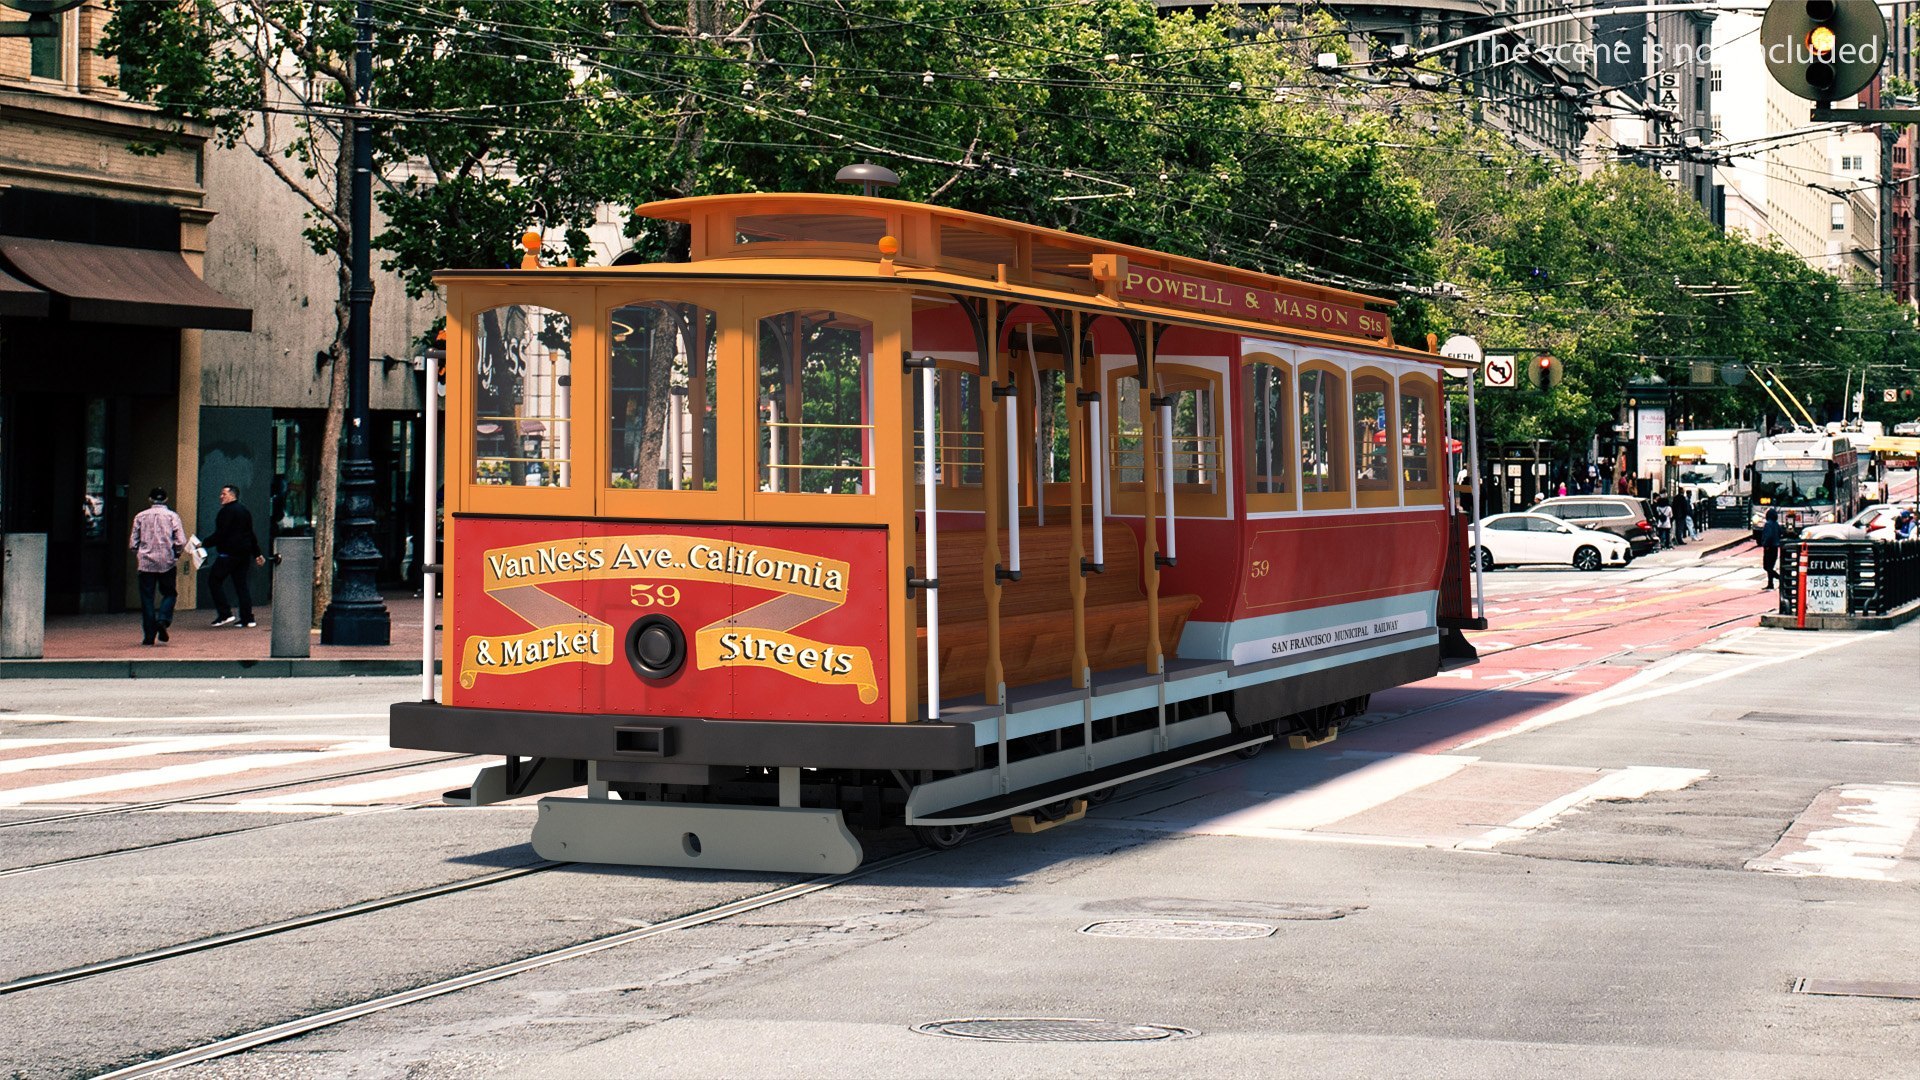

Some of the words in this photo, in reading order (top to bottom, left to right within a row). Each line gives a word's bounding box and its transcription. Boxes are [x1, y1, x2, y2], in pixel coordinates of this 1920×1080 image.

[1125, 273, 1232, 306] POWELL
[1245, 291, 1261, 309] &
[1274, 297, 1349, 326] MASON
[1358, 315, 1384, 332] Sts.
[489, 553, 535, 580] Van
[537, 547, 604, 575] Ness
[688, 544, 843, 592] California
[1251, 559, 1270, 578] 59
[1808, 560, 1823, 570] EFT
[1825, 560, 1845, 570] LANE
[630, 583, 681, 607] 59
[1807, 590, 1823, 599] TAXI
[1825, 590, 1844, 598] ONLY
[1813, 578, 1829, 587] BUS
[476, 640, 496, 665] &
[499, 629, 600, 667] Market
[1271, 640, 1288, 653] SAN
[1290, 632, 1332, 650] FRANCISCO
[1334, 625, 1369, 642] MUNICIPAL
[1373, 620, 1399, 634] RAILWAY
[720, 632, 854, 676] Streets
